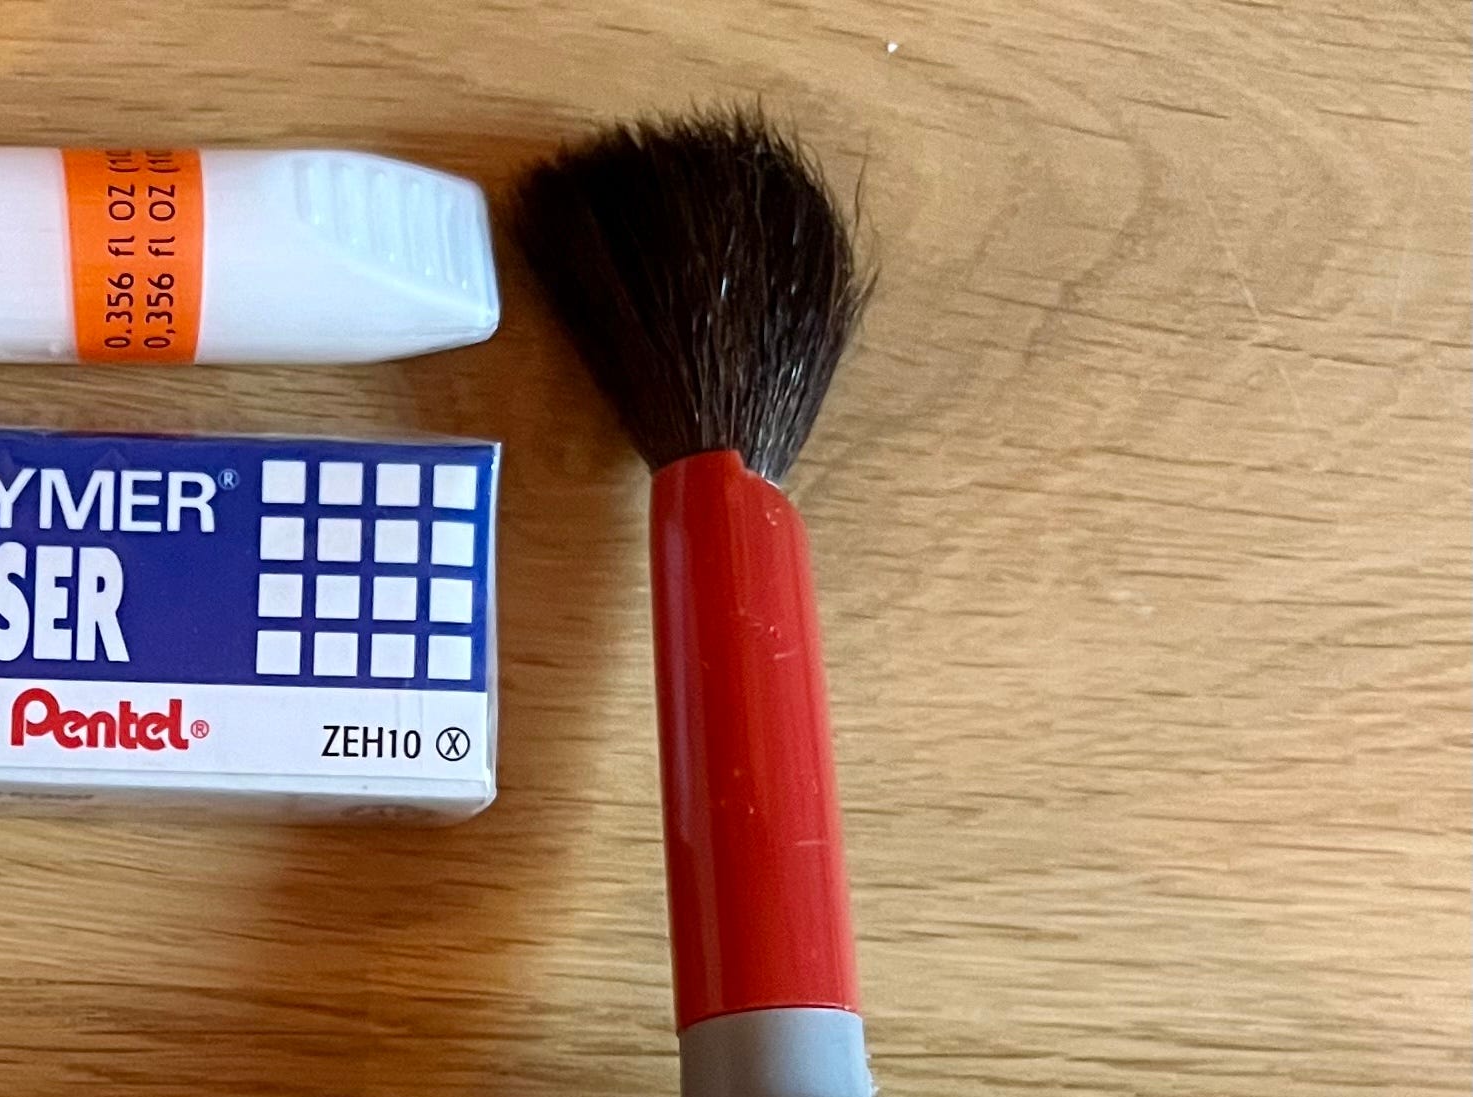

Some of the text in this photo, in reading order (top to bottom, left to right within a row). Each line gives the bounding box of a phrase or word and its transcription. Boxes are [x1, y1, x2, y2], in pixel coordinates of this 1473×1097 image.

[108, 235, 135, 257] fl
[147, 235, 175, 257] fl
[103, 272, 135, 349] 0.356
[144, 272, 176, 349] 0,356
[322, 726, 421, 759] ZEH10
